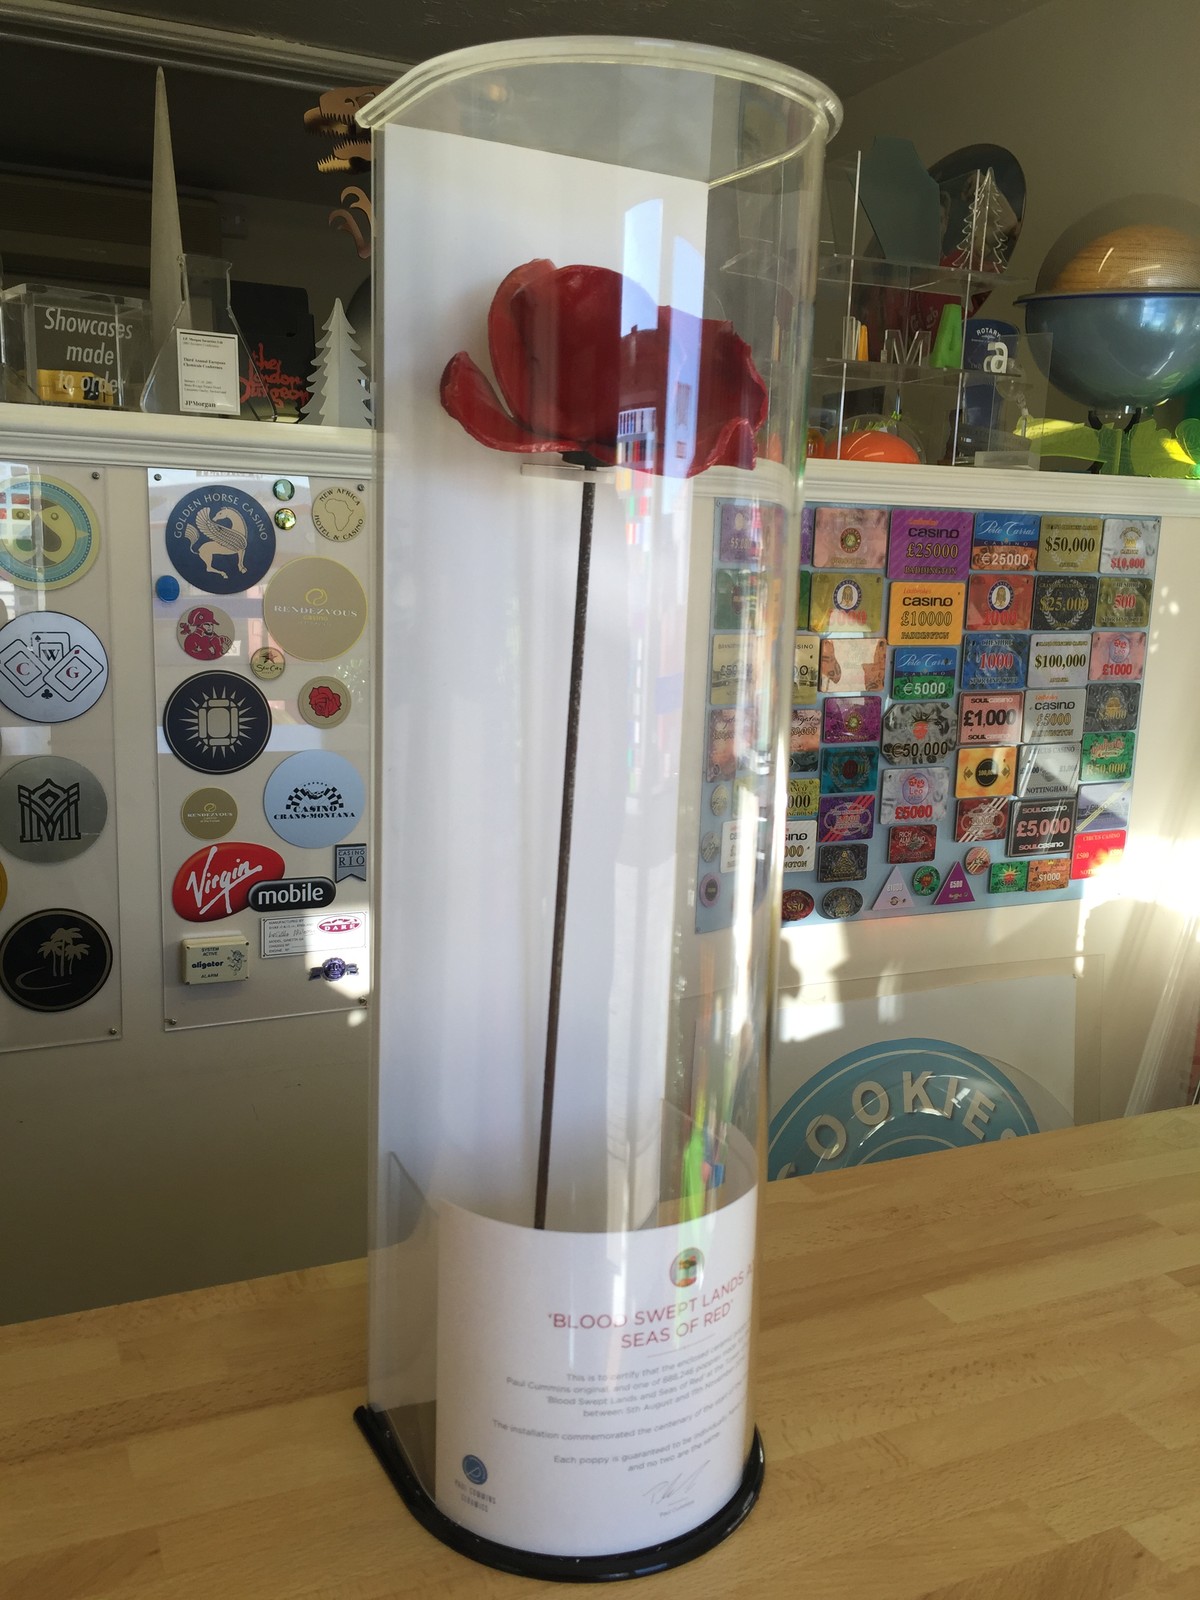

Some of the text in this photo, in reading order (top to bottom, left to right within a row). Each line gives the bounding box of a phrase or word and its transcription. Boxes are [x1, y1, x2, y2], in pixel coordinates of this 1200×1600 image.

[44, 307, 133, 339] Showcases
[976, 328, 1001, 338] ROTARY
[66, 342, 114, 365] made
[80, 371, 126, 394] order
[336, 488, 360, 506] AFRICA
[173, 493, 268, 541] GOLDEN HORSE CASINO
[314, 514, 331, 538] HOTEL
[342, 518, 364, 540] CASINO
[908, 527, 960, 539] casino
[906, 542, 959, 559] £25000
[1044, 536, 1096, 554] $50,000
[981, 552, 1029, 567] €25000
[902, 596, 953, 607] casino
[1113, 594, 1137, 609] 500
[274, 604, 359, 617] RENDEZVOUS
[900, 611, 953, 627] £10000
[41, 649, 60, 661] W
[980, 652, 1013, 670] 1000
[1034, 654, 1087, 670] $100,000
[16, 662, 30, 676] C
[65, 666, 80, 679] G
[1102, 663, 1132, 676] £1000
[903, 682, 946, 696] €5000
[1034, 700, 1076, 711] casino
[963, 708, 1017, 728] £1,000
[273, 812, 356, 820] CRANS-MONTANA
[293, 805, 338, 813] CASINO
[895, 805, 933, 820] £5000
[1016, 817, 1071, 837] £5,000
[338, 856, 366, 866] RIO
[185, 846, 263, 915] Virgin
[258, 883, 324, 905] mobile
[191, 961, 224, 969] aligator
[777, 1070, 1017, 1180] OOKIE
[634, 1297, 698, 1327] SWEPT
[702, 1270, 745, 1308] LANDS
[621, 1327, 671, 1349] SEAS
[675, 1318, 699, 1338] OF
[553, 1455, 578, 1464] Each
[578, 1456, 610, 1466] poppy
